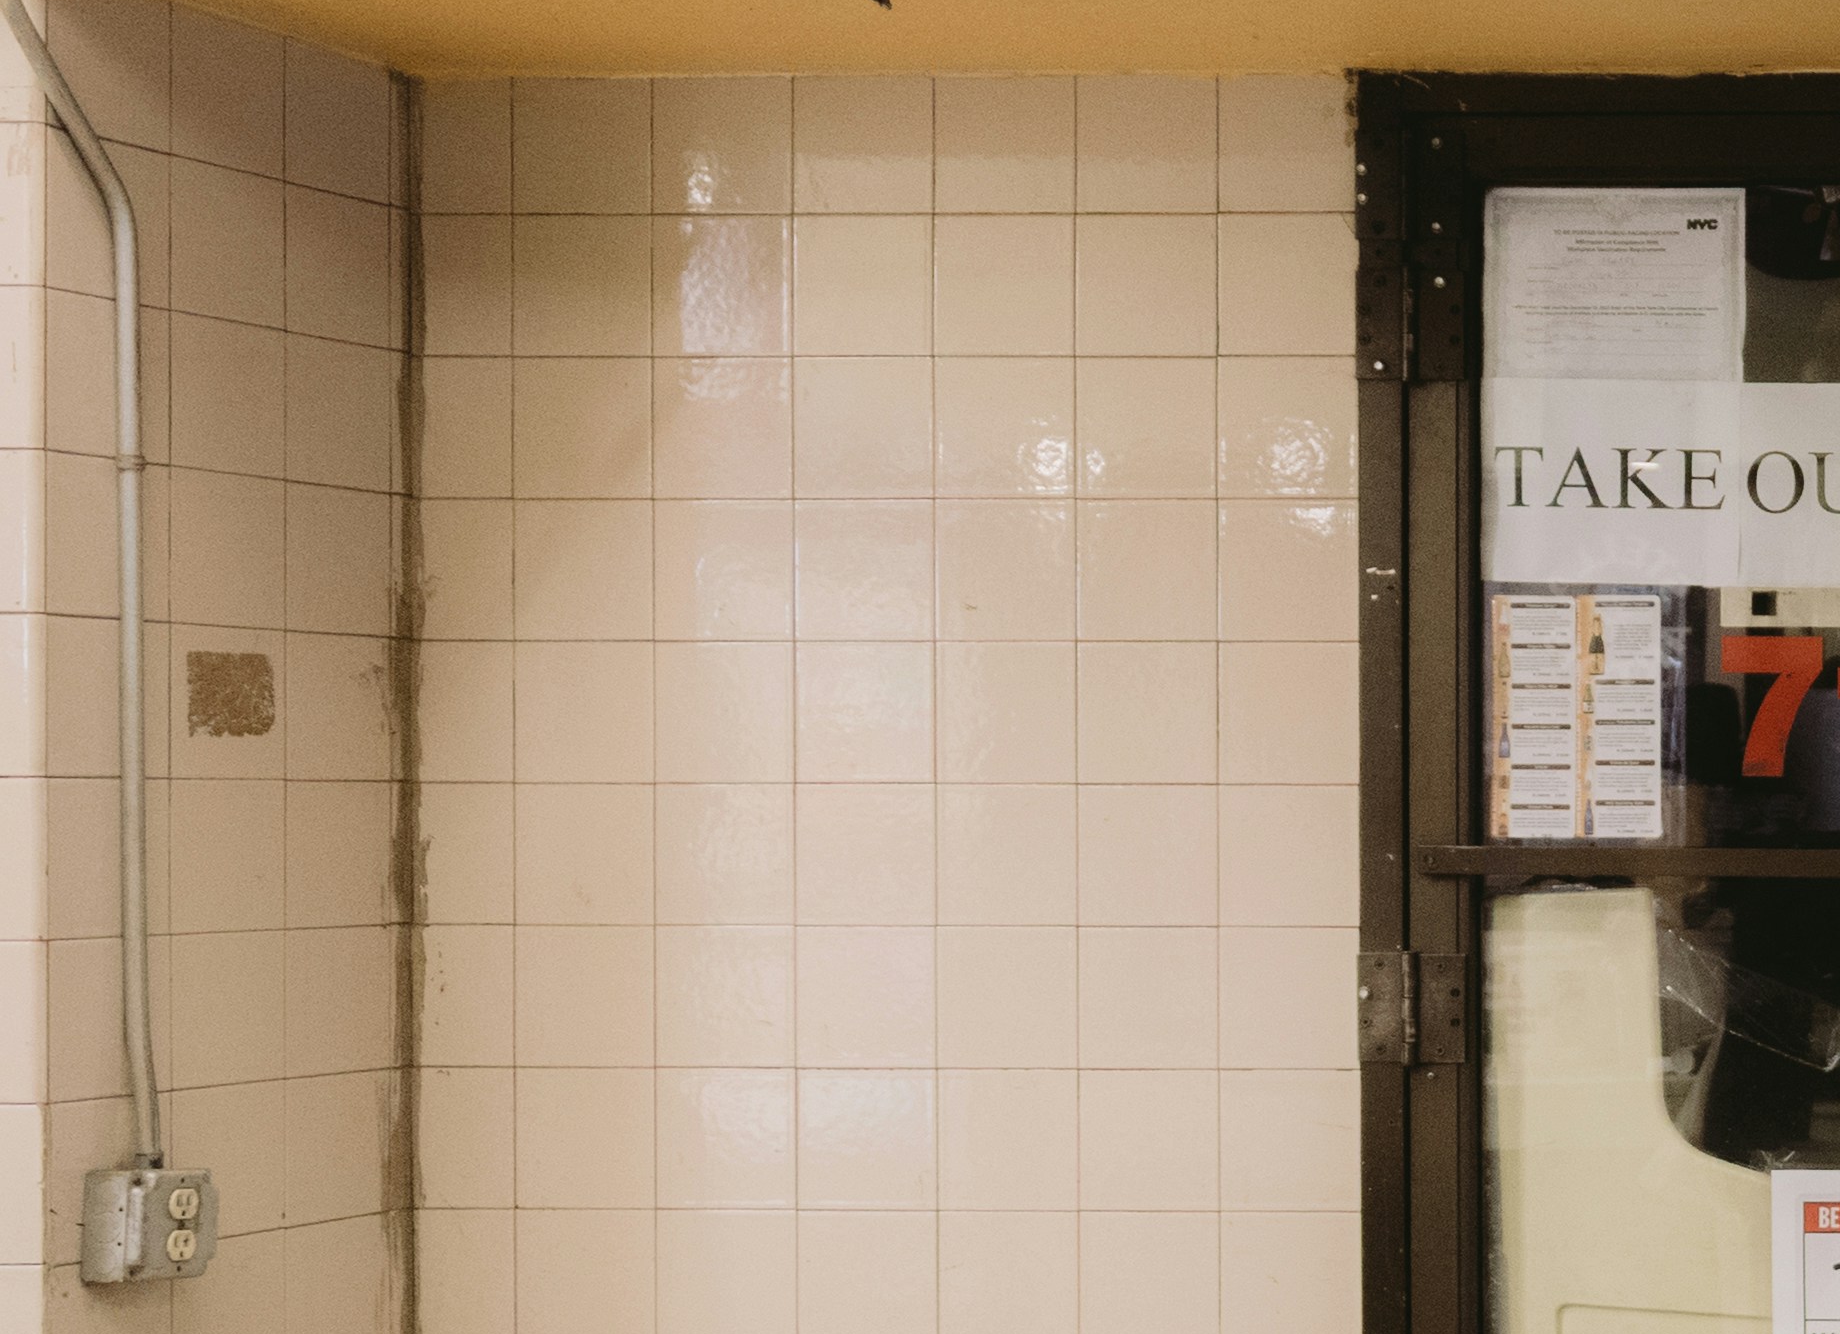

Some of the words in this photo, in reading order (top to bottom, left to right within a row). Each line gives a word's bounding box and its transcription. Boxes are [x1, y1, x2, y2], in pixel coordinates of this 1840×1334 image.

[1686, 218, 1719, 230] NYC
[1494, 445, 1726, 511] TAKE
[1818, 1206, 1840, 1229] BE
